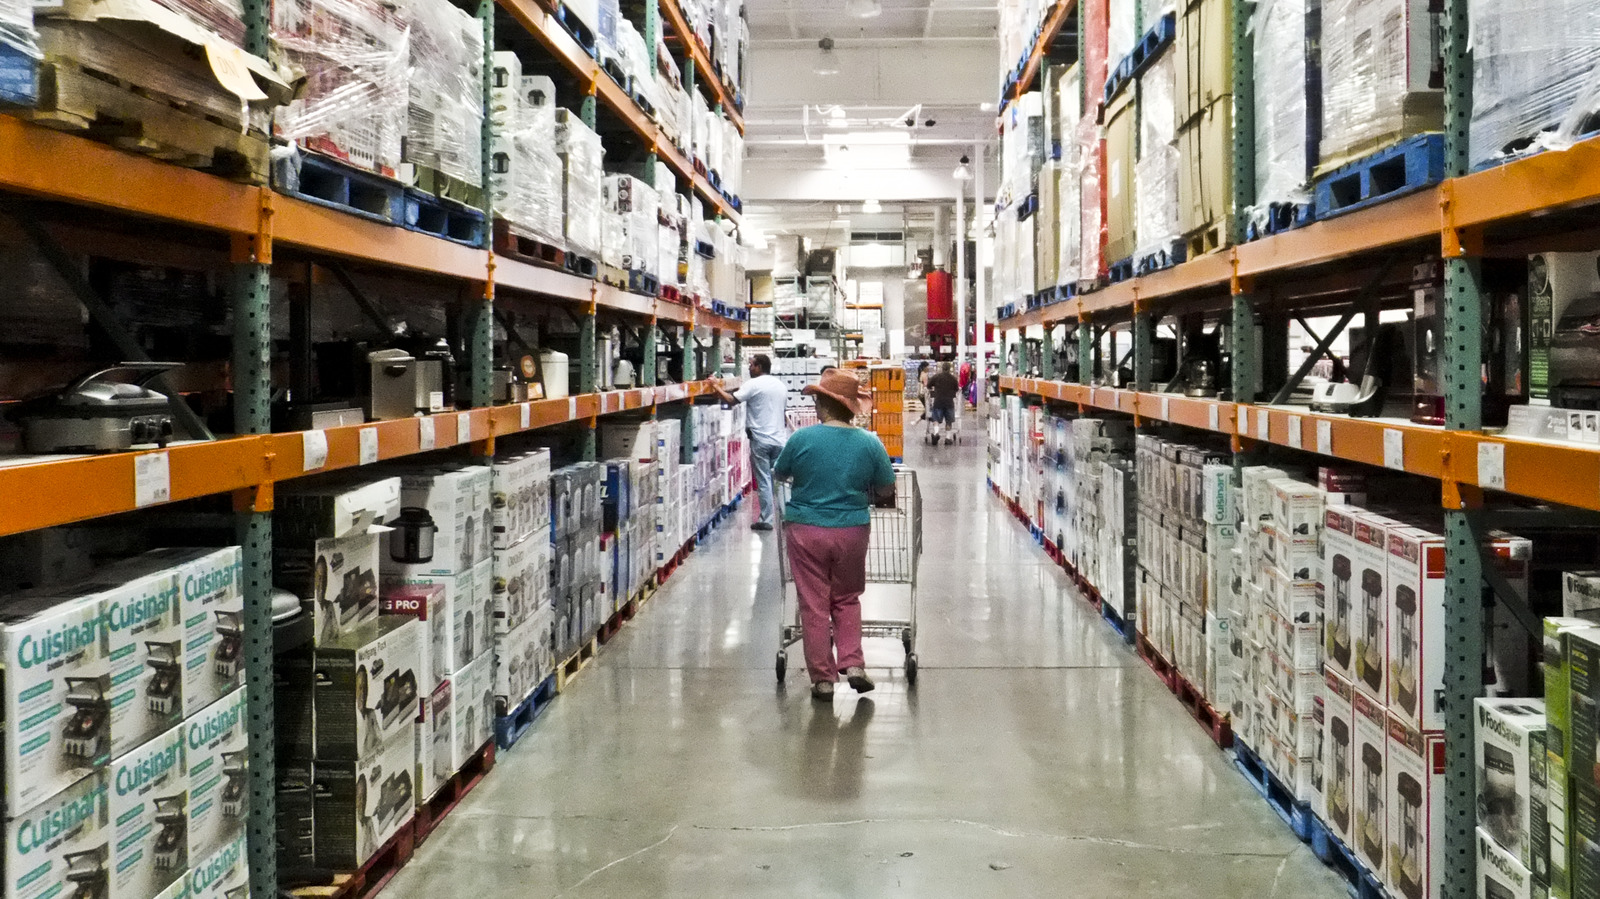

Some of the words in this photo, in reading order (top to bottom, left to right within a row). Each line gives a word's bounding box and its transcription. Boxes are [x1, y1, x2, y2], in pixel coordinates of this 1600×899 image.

[1215, 472, 1225, 521] Cuisinart
[184, 561, 243, 601] Cuisinart
[395, 600, 420, 610] PRO
[109, 586, 180, 632] Cuisinart
[18, 610, 111, 669] Cuisinart
[188, 701, 248, 750] Cuisinart
[1486, 712, 1522, 748] FoodSaver
[115, 737, 185, 797] Cuisinart
[17, 782, 109, 855] Cuisinart
[192, 836, 247, 895] Cuisinart
[1486, 845, 1524, 888] FoodSaver
